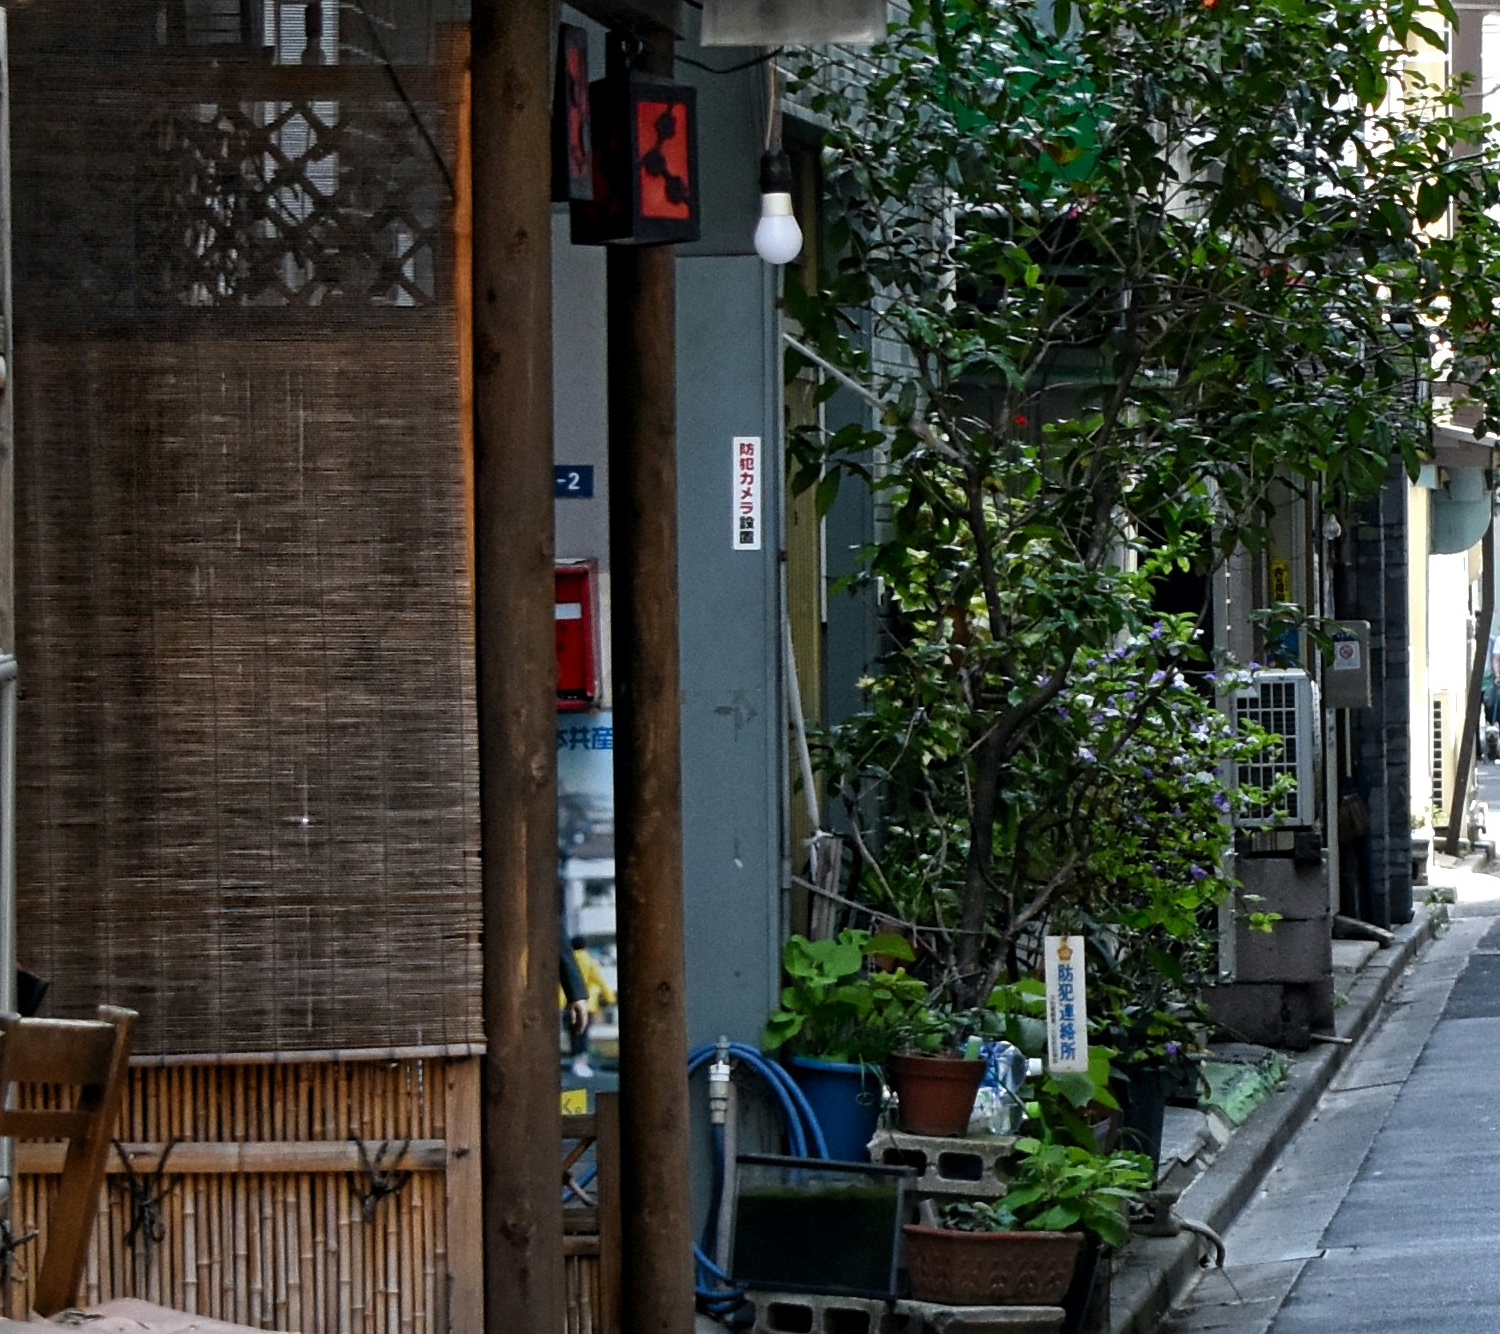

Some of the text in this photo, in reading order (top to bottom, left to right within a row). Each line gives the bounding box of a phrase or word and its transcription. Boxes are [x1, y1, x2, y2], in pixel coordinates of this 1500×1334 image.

[739, 442, 755, 544] 防犯カメラ設置
[1057, 963, 1076, 1061] 防犯連絡所
